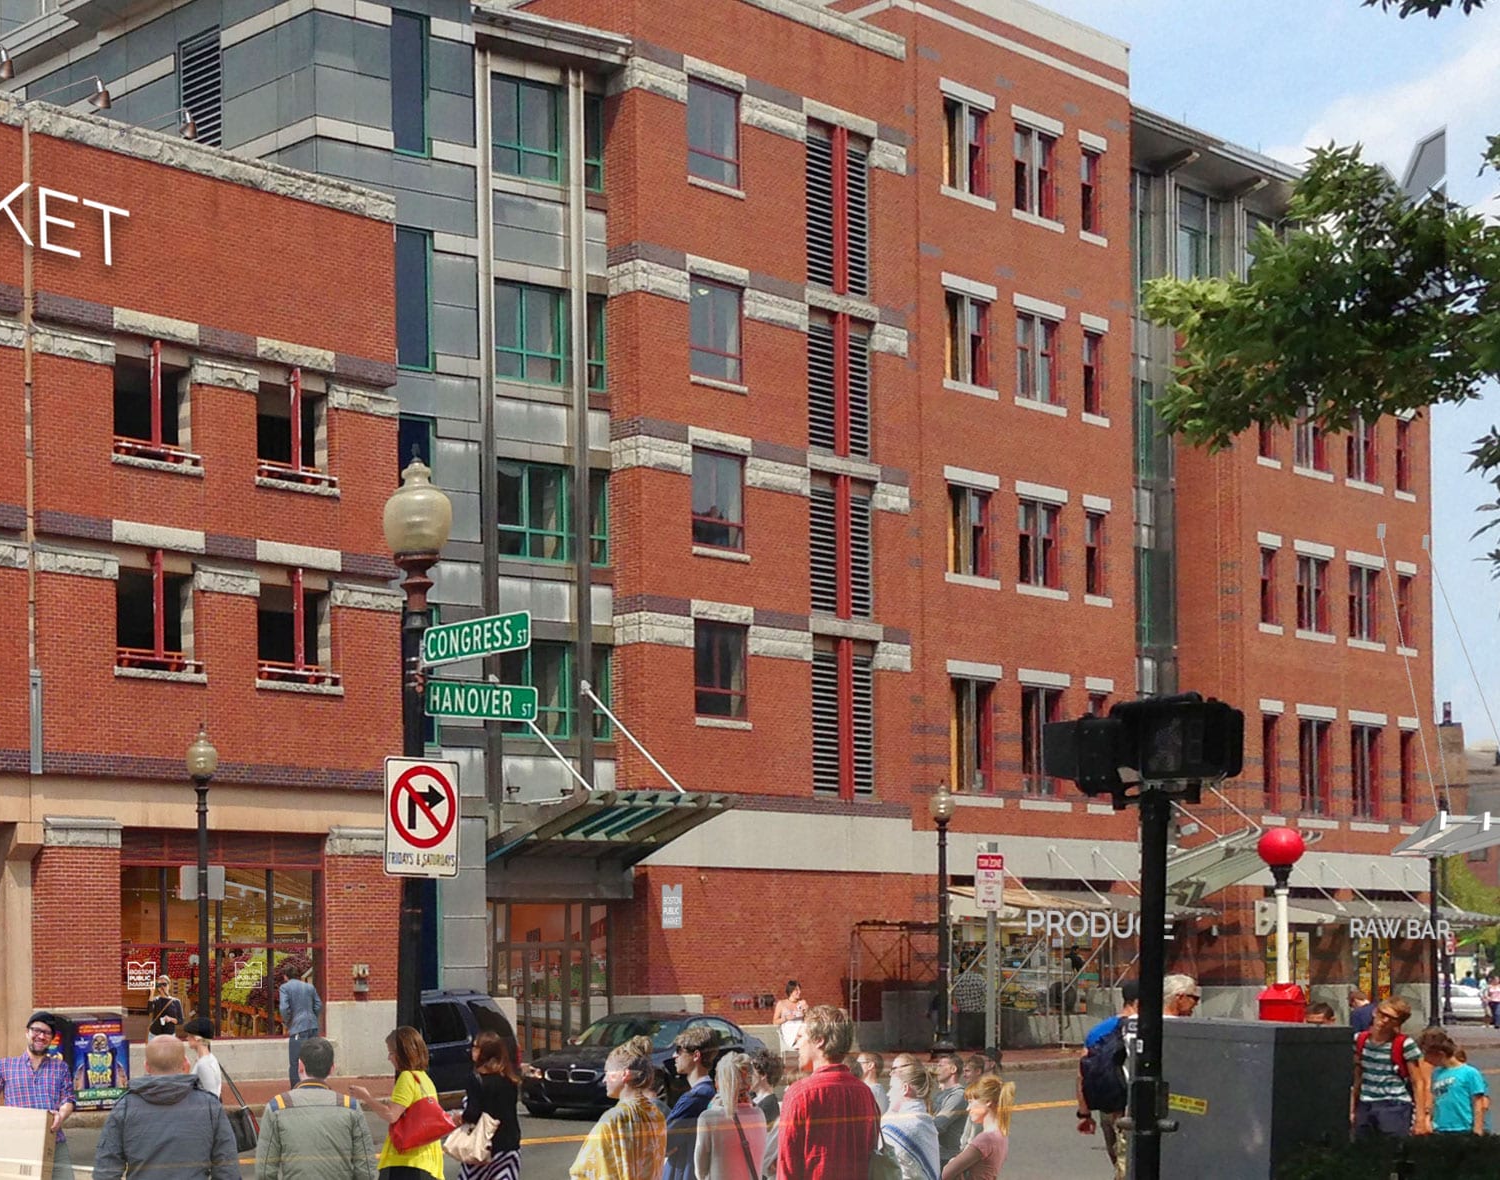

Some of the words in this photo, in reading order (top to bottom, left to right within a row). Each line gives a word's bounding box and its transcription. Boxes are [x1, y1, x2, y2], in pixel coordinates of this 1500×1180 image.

[427, 619, 512, 658] CONGRESS
[517, 629, 527, 643] ST
[430, 686, 512, 715] HANOVER
[521, 703, 532, 716] ST
[388, 852, 414, 865] FRIDAYS
[421, 853, 455, 867] SATURDAYS
[1026, 910, 1175, 940] PRODUE
[1349, 918, 1401, 939] RAW
[1406, 920, 1451, 939] BAR
